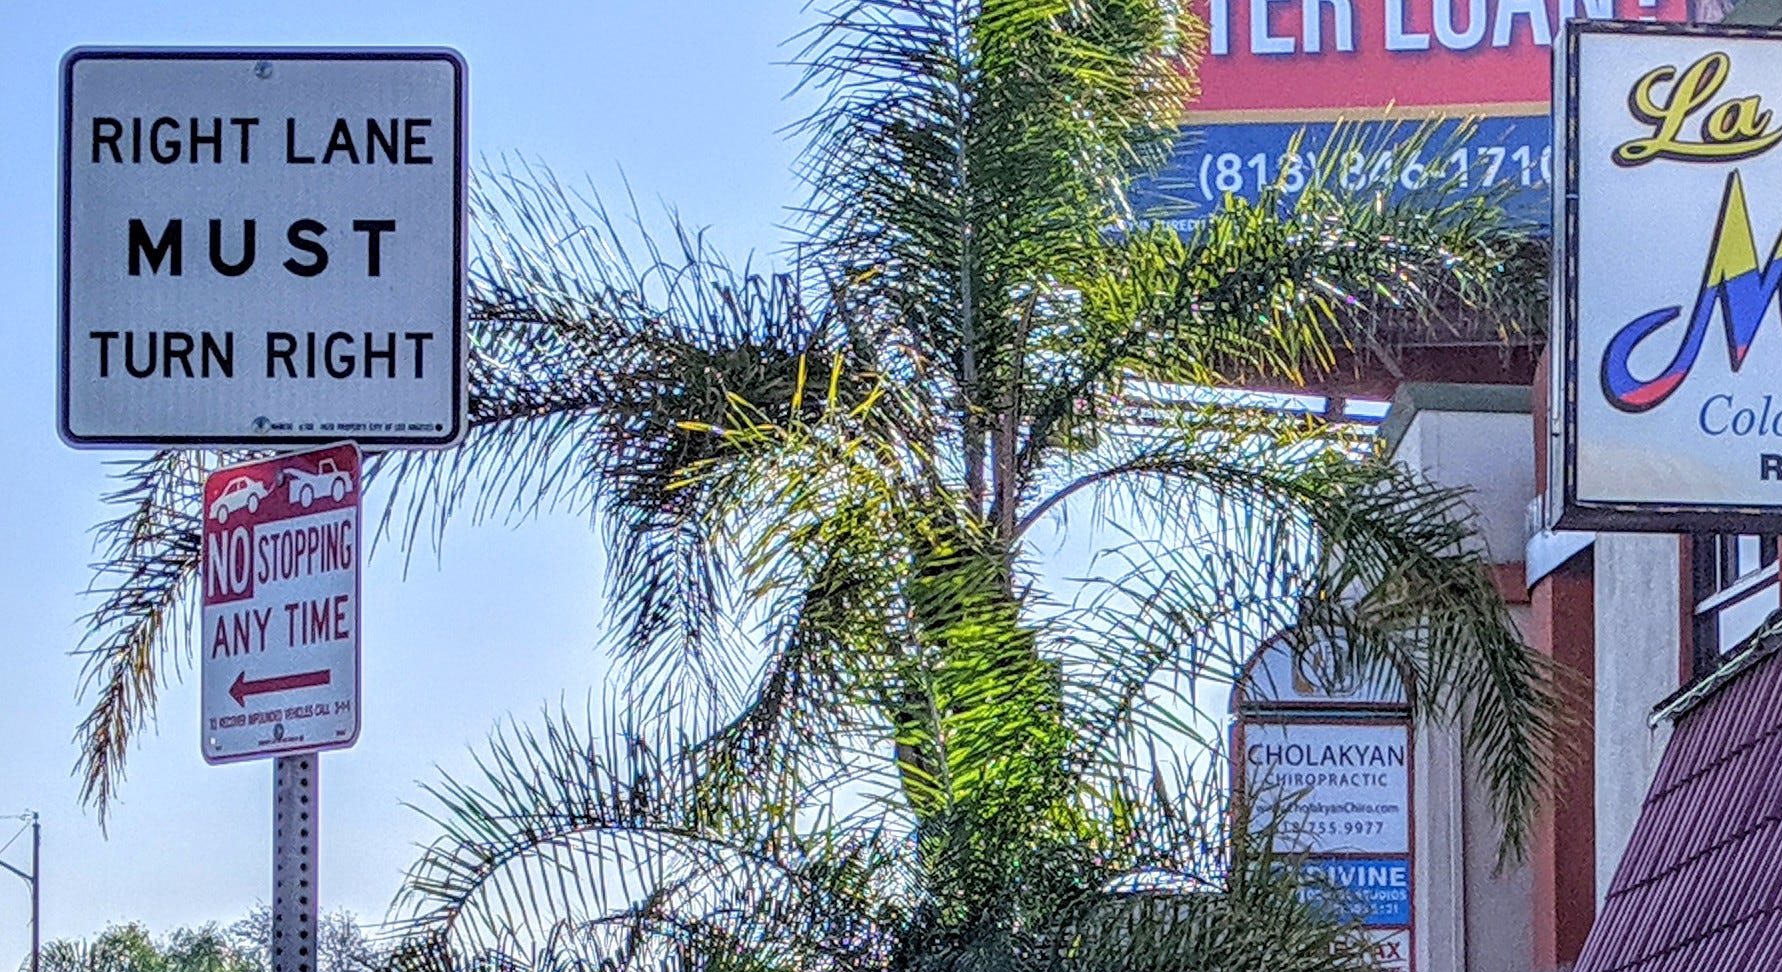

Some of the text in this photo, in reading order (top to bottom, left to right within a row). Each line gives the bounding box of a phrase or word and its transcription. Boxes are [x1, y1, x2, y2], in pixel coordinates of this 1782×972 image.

[91, 117, 434, 166] RIGHT LANE
[127, 218, 397, 278] MUST
[89, 331, 434, 380] TURN RIGHT
[207, 519, 352, 598] NO STOPPING
[211, 594, 349, 660] ANY TIME
[1247, 743, 1405, 767] CHOLAKYAN
[1265, 772, 1388, 787] CHIROPRACTIC
